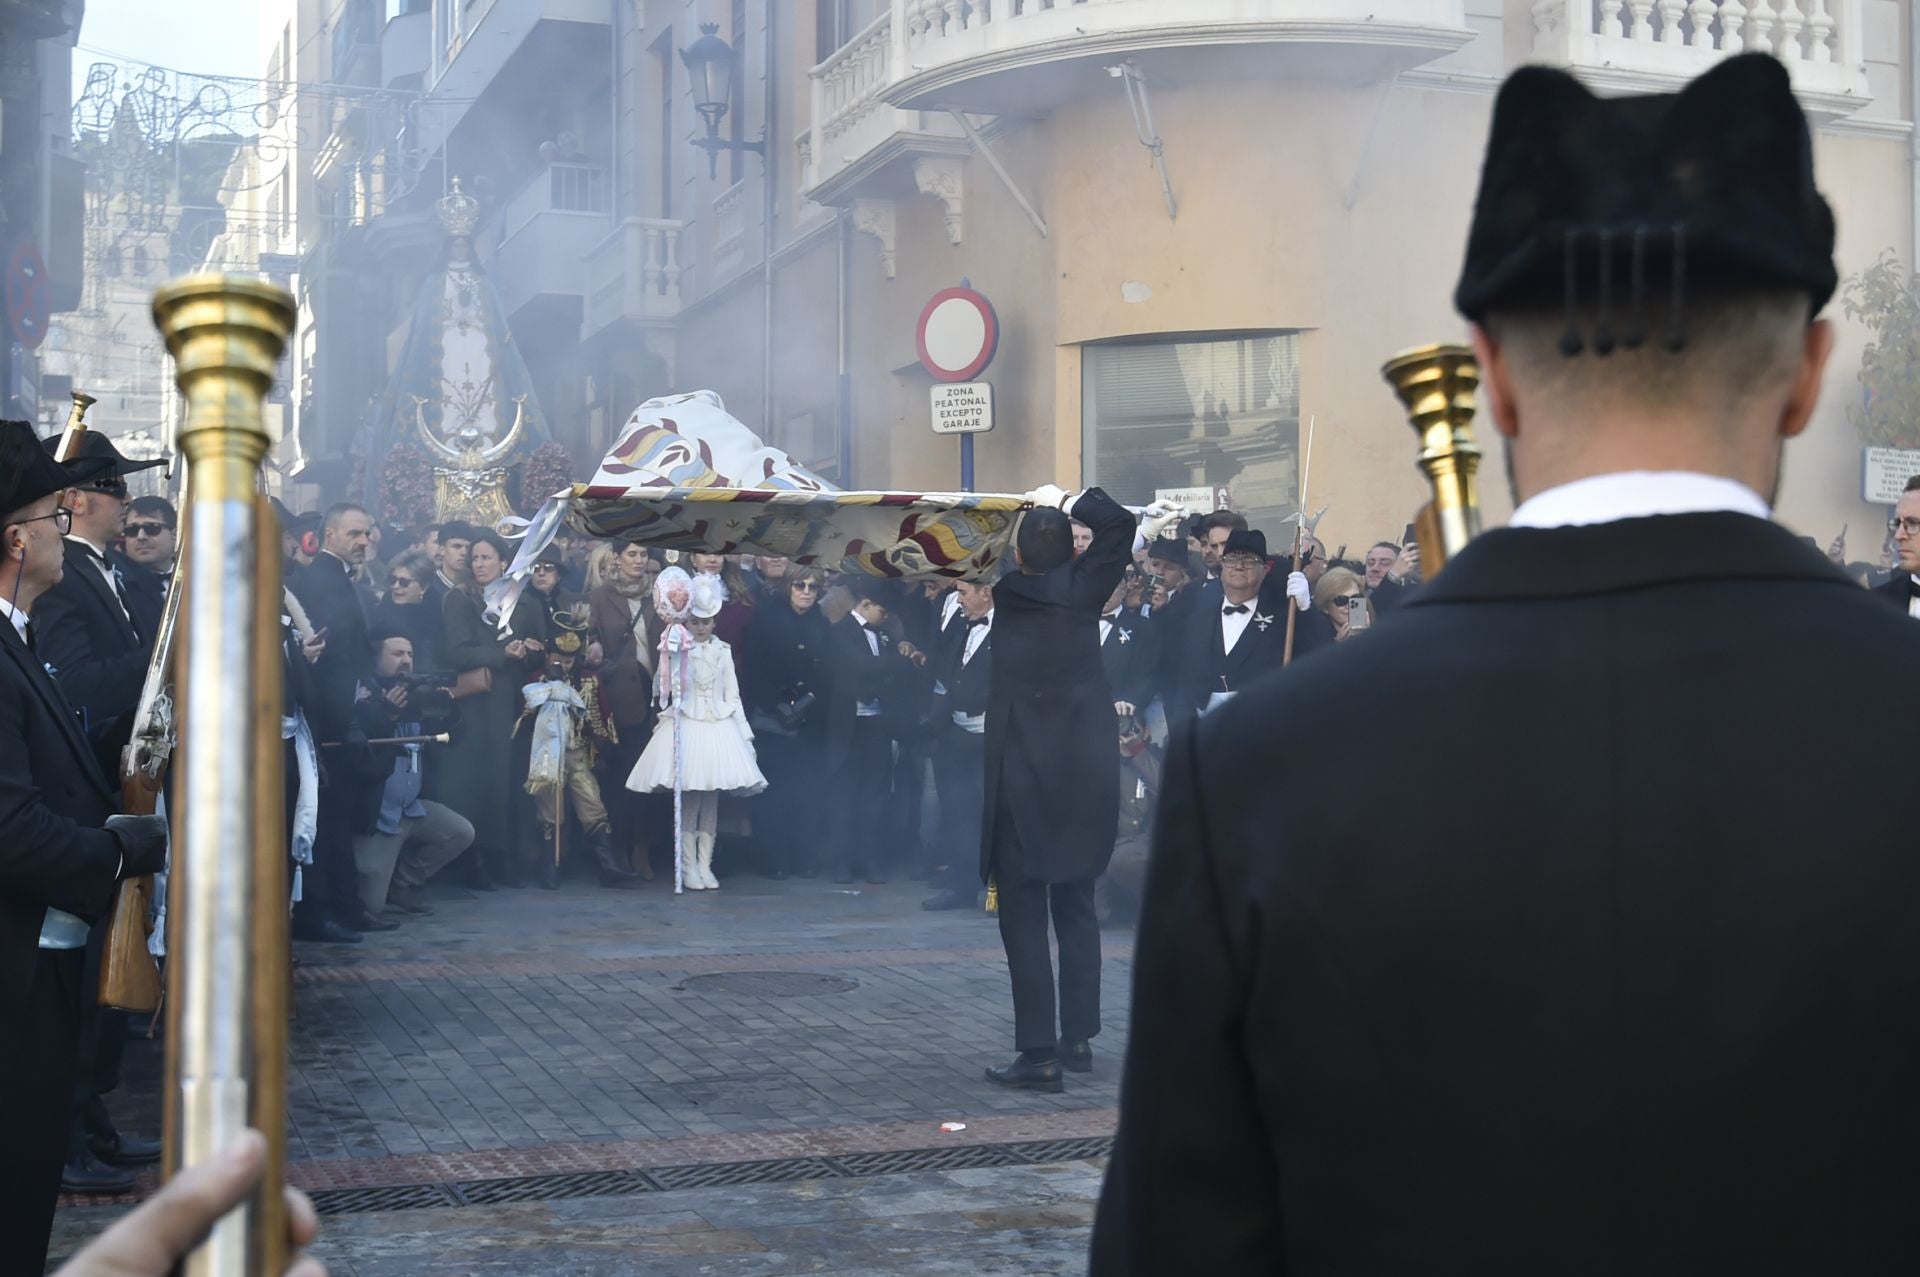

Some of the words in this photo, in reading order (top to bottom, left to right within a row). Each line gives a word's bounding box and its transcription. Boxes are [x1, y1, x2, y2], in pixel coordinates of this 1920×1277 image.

[946, 387, 974, 397] ZONA
[934, 396, 987, 408] PEATONAL
[940, 407, 983, 418] EXCEPTO
[942, 418, 981, 429] GARAJE
